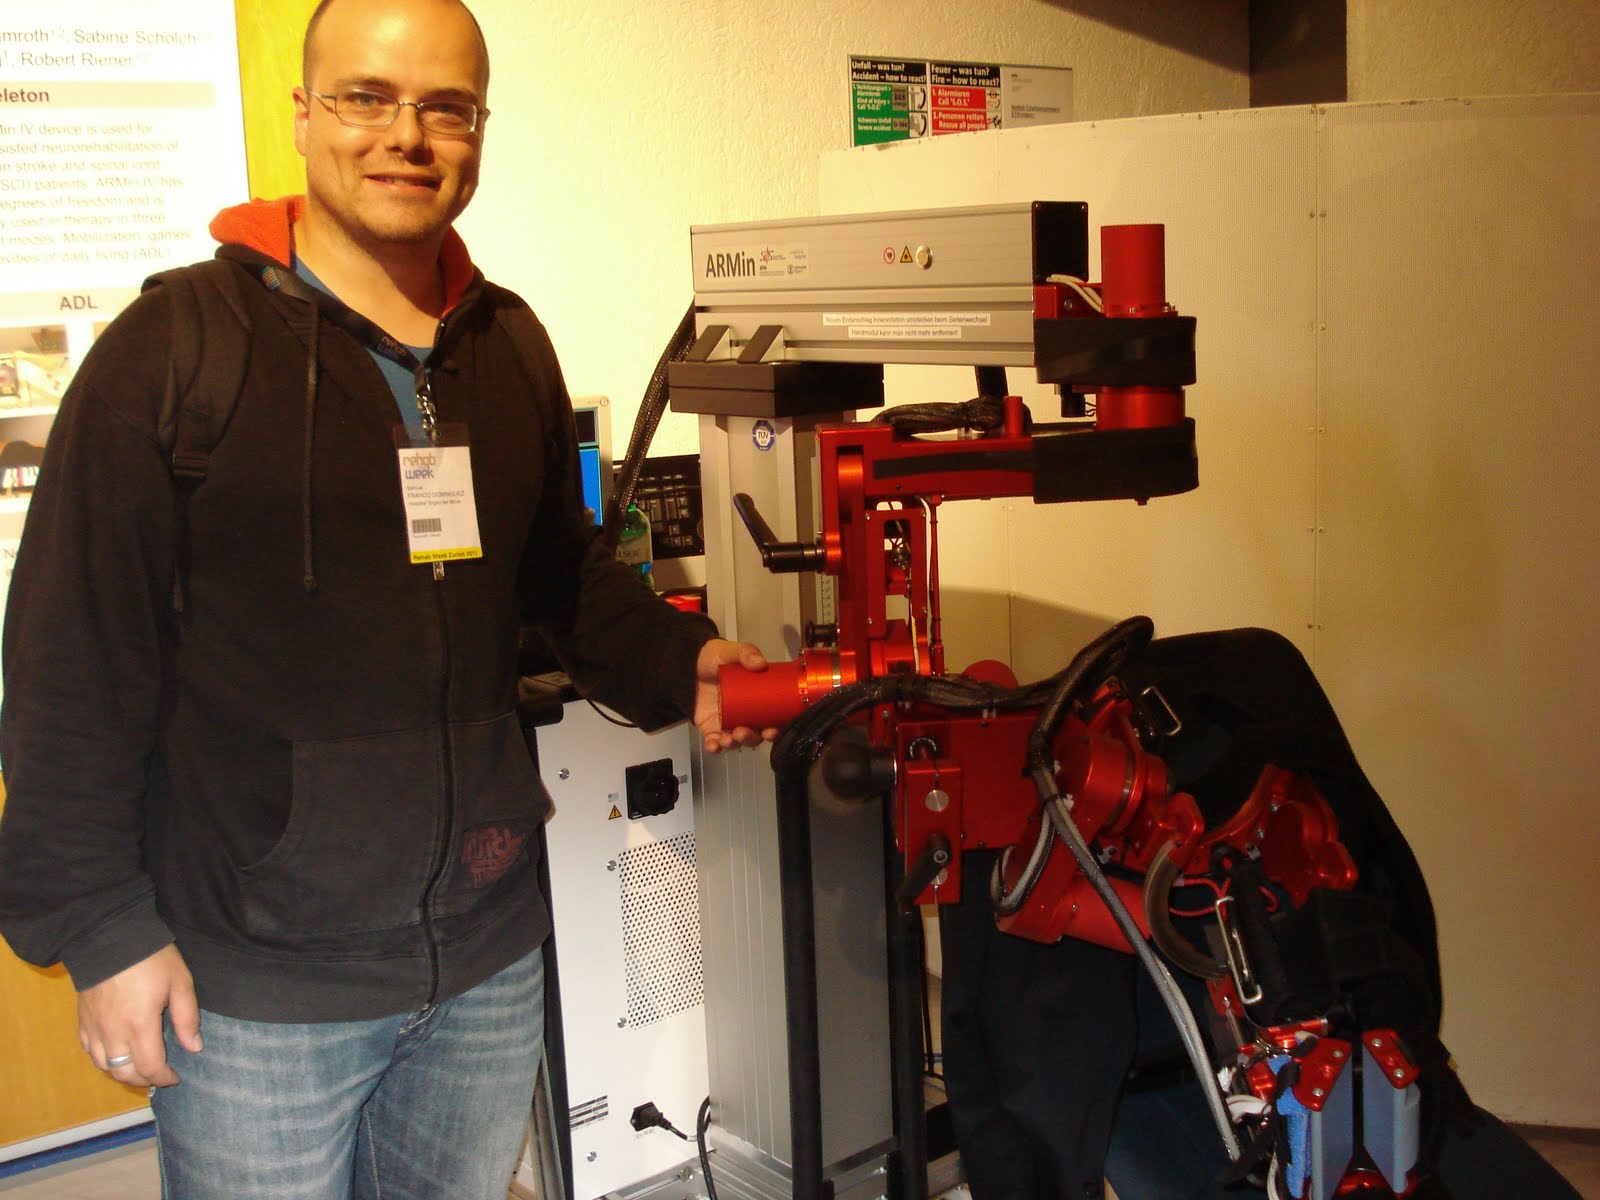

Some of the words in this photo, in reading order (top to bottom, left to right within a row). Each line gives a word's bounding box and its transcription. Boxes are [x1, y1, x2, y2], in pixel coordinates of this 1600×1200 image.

[0, 28, 49, 43] mroth
[74, 29, 129, 44] Sabine
[21, 52, 76, 67] Robert
[852, 60, 871, 70] Unfall
[891, 63, 905, 72] tun?
[931, 64, 951, 74] Feuer
[974, 67, 990, 76] tun?
[852, 72, 879, 81] Accident
[885, 73, 899, 82] how
[908, 75, 927, 83] react?
[931, 74, 945, 83] Fire
[952, 76, 968, 85] how
[969, 77, 977, 86] to
[978, 77, 1000, 87] react?
[39, 123, 81, 135] device
[16, 161, 57, 173] stroke
[148, 230, 192, 243] games
[706, 250, 756, 278] ARMin
[59, 295, 98, 311] ADL
[403, 451, 436, 466] rehab
[405, 466, 434, 480] week
